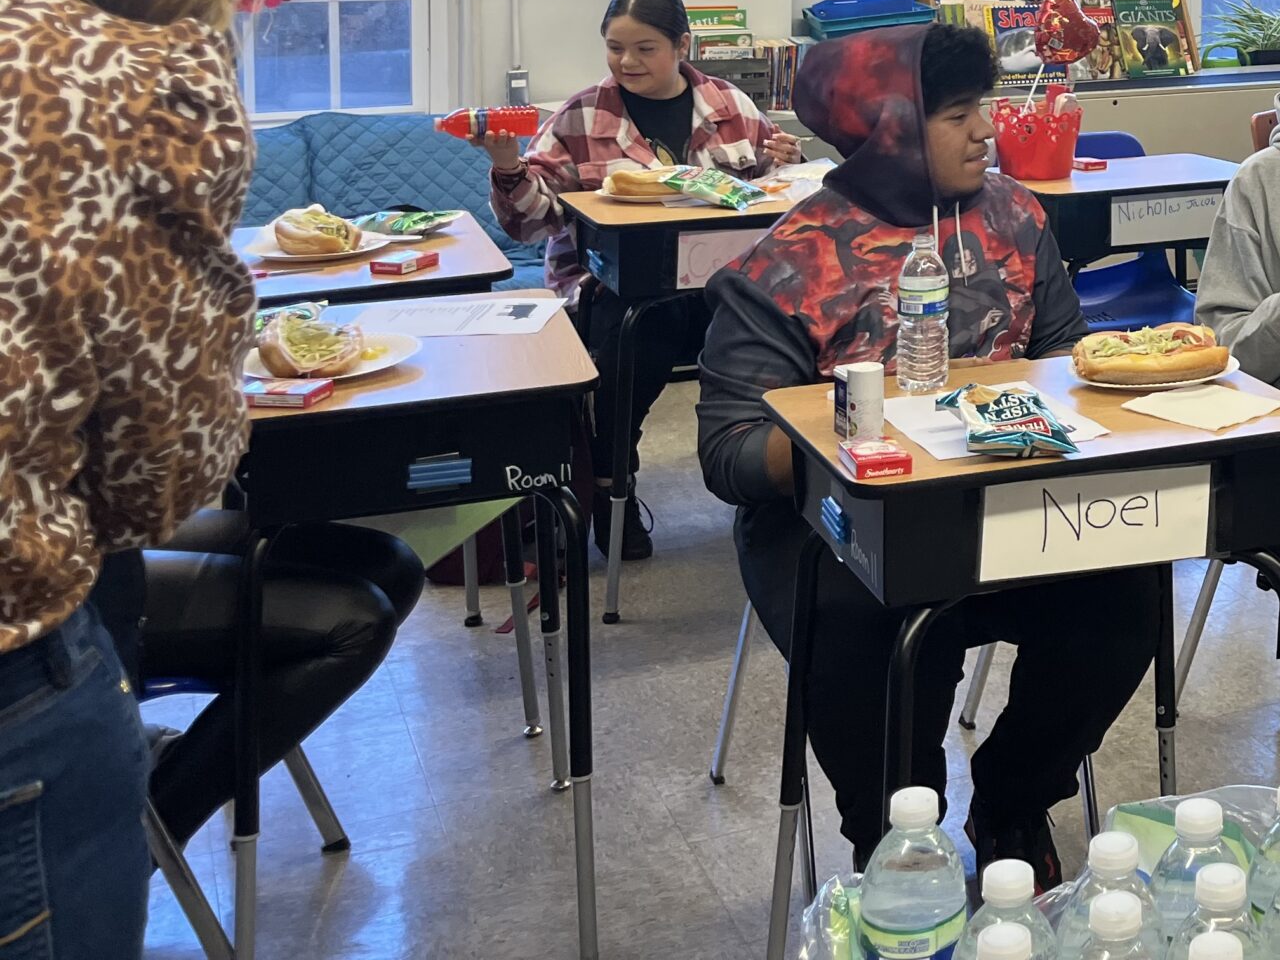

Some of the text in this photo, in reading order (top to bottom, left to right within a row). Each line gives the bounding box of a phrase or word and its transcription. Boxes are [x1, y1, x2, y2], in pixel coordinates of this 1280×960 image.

[1120, 10, 1176, 23] GIANTS
[1118, 199, 1181, 225] Nicholas
[988, 395, 1035, 412] ASTY
[1001, 404, 1037, 420] RISP
[505, 463, 572, 491] Room 11
[865, 467, 904, 478] Sweethearts
[1042, 488, 1159, 553] Noel
[851, 528, 870, 574] Room
